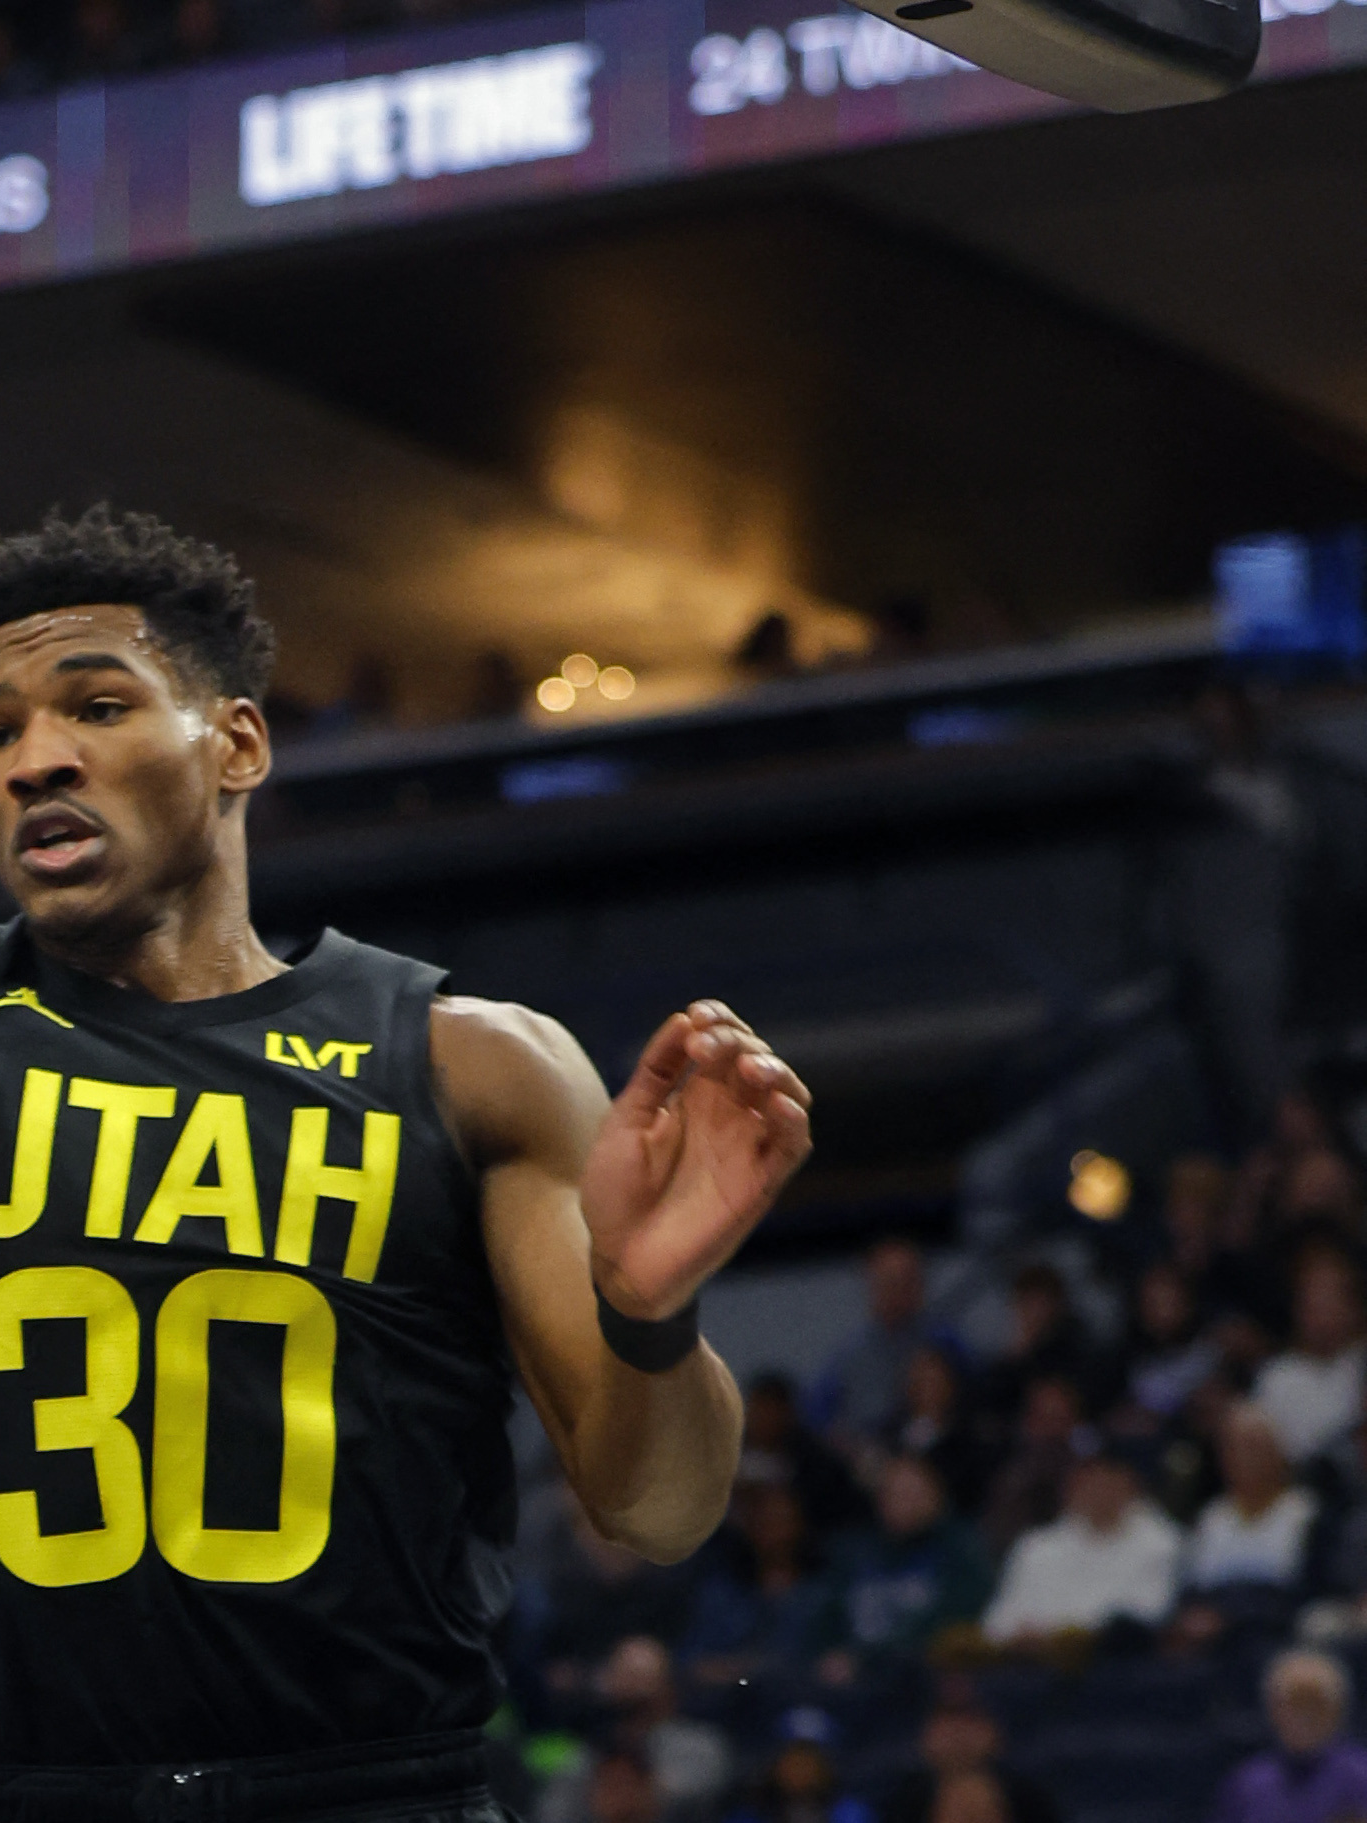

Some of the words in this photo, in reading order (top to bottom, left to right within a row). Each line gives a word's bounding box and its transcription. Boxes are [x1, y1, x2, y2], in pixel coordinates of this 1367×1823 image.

[690, 28, 789, 114] 24
[240, 78, 396, 206] LIFE
[399, 43, 604, 180] TIME
[265, 1030, 373, 1078] LVT
